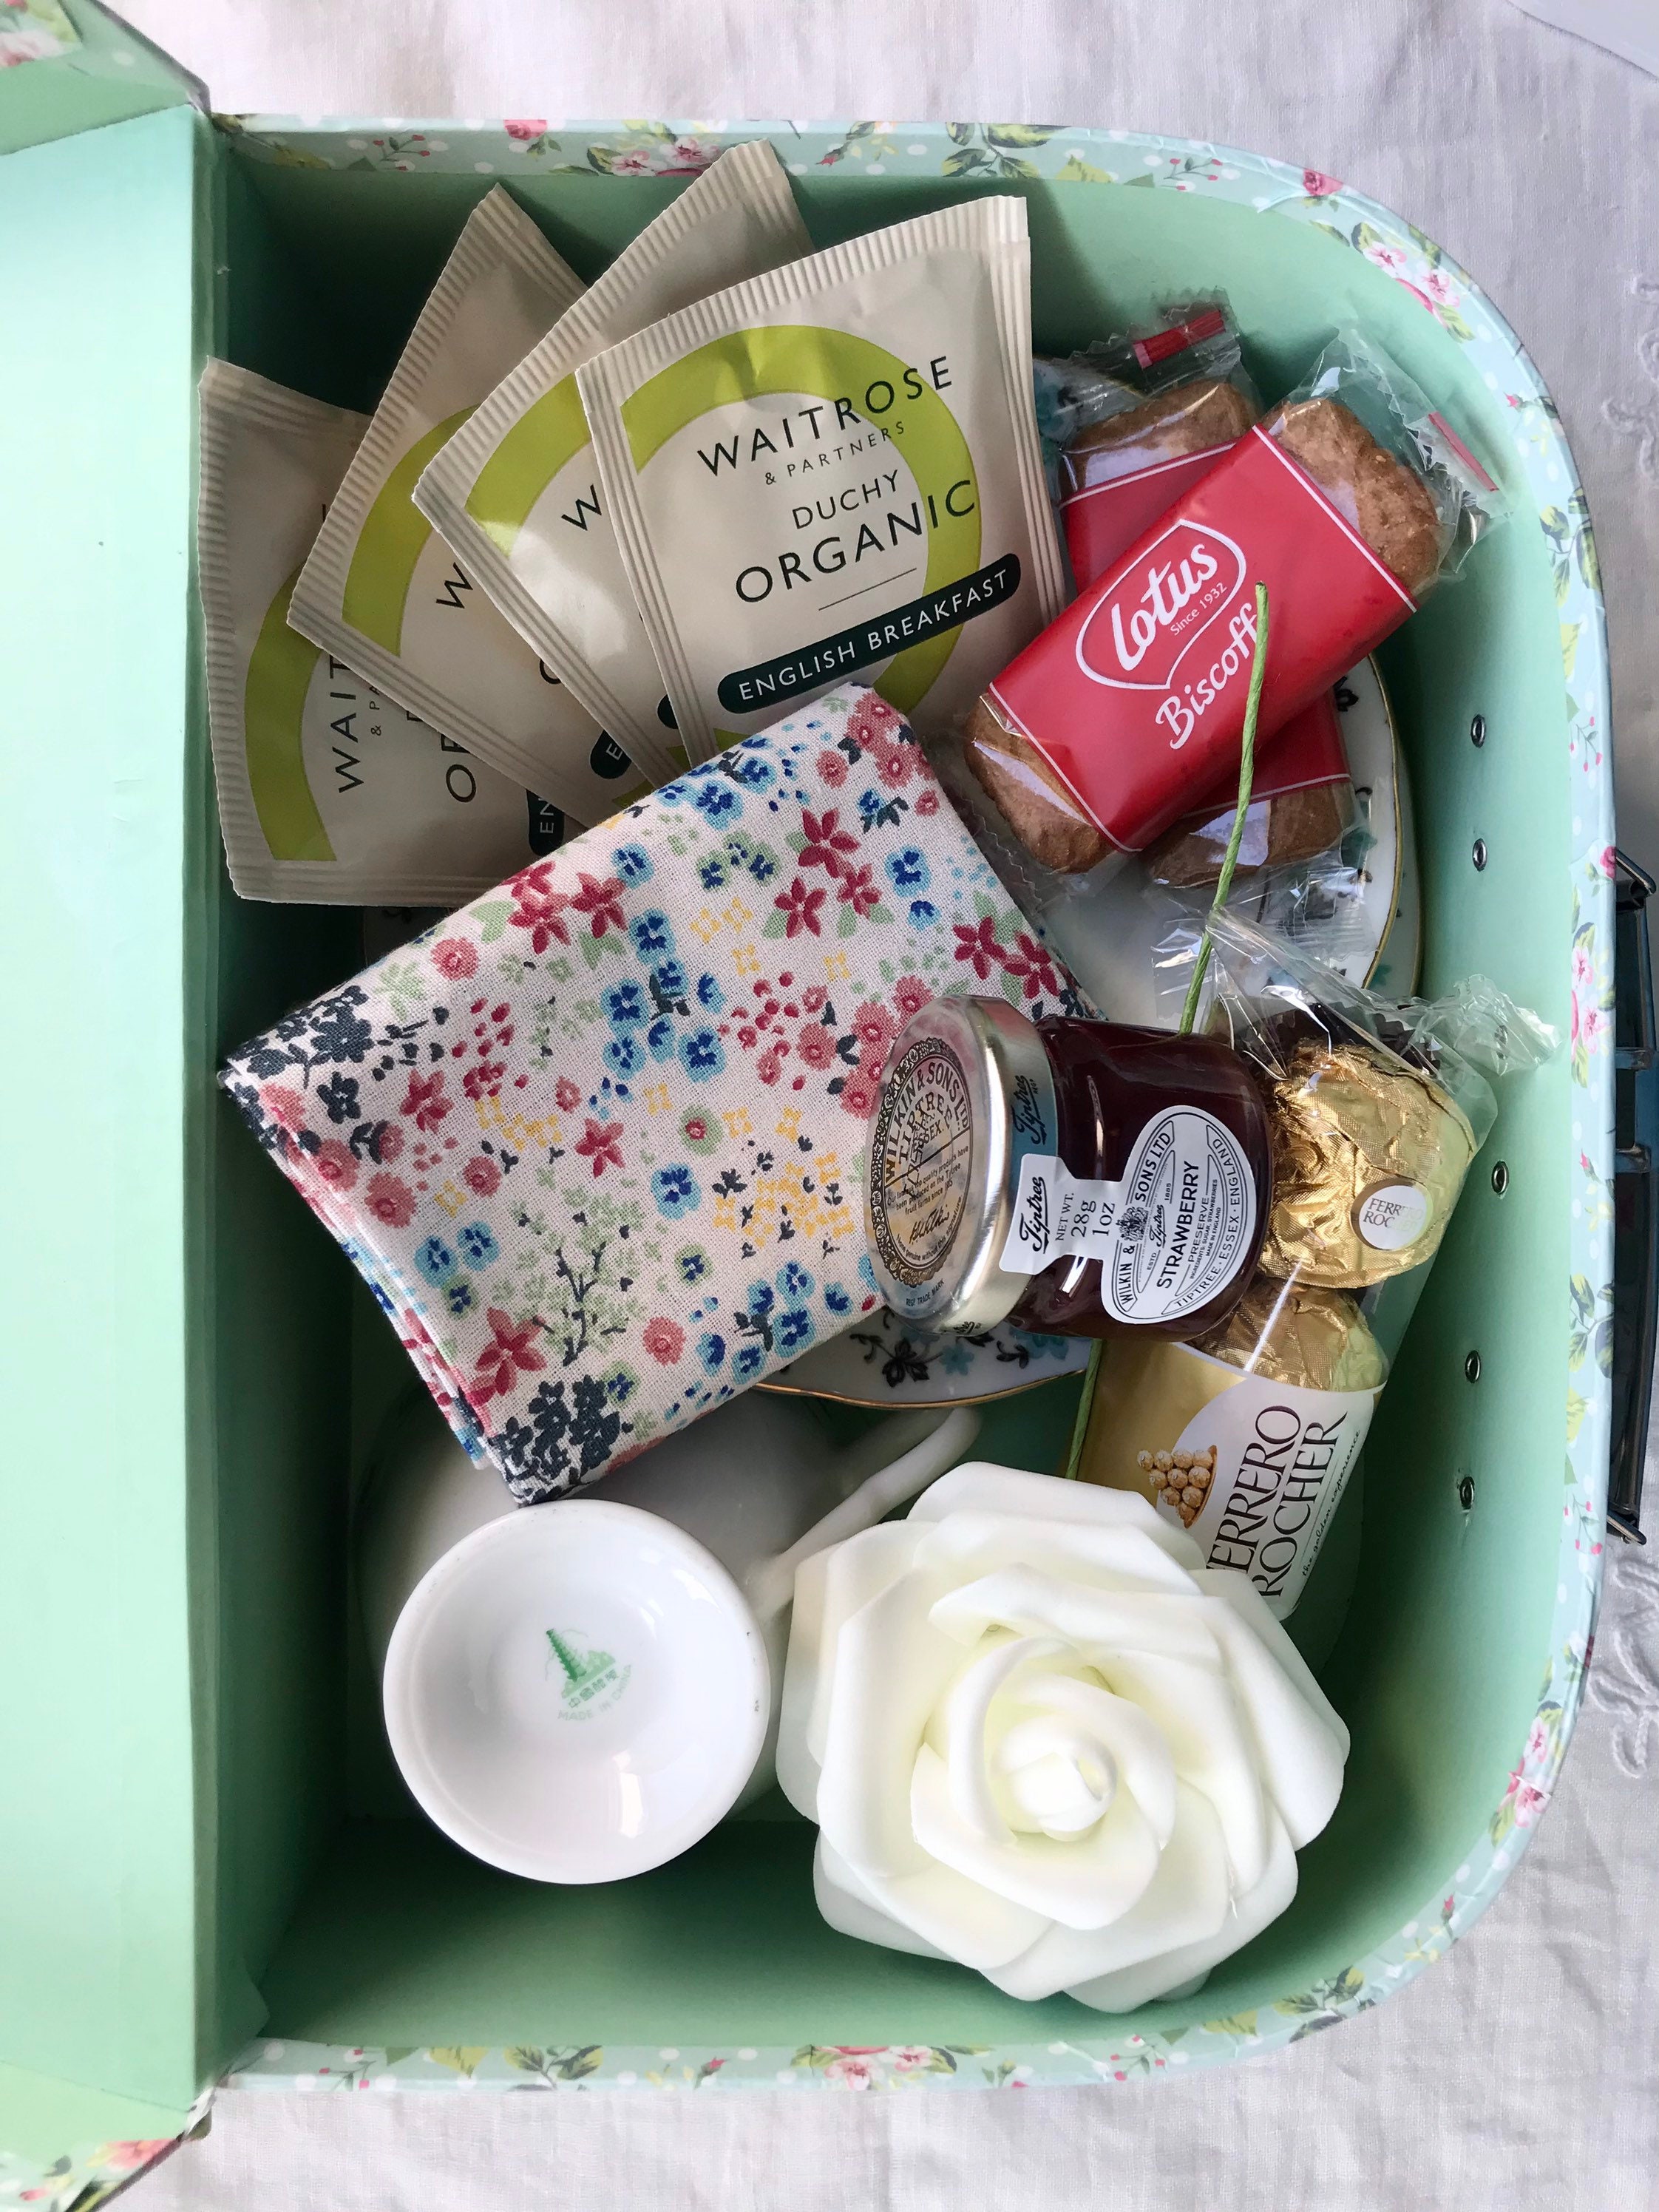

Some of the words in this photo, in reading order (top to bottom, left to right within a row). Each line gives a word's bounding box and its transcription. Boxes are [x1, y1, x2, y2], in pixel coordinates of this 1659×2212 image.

[696, 356, 952, 476] WAITROSE
[764, 471, 777, 486] &
[787, 421, 906, 477] PARTNERS
[792, 469, 900, 530] DUCHY
[736, 480, 976, 603] ORGANIC
[739, 642, 855, 702] ENGLISH
[868, 569, 1008, 651] BREAKFAST
[1111, 543, 1218, 671] Lotus
[1170, 608, 1200, 636] Since
[1199, 582, 1228, 609] 1932
[1155, 603, 1258, 750] Biscoff
[330, 655, 364, 793] WAIT
[885, 1077, 916, 1183] WILKIN
[917, 1068, 926, 1091] &
[926, 1062, 960, 1102] SONS
[1011, 1074, 1048, 1145] Tiptree
[1150, 1133, 1171, 1158] LTD
[1212, 1139, 1241, 1205] ENGLAND
[1061, 1192, 1074, 1215] WT.
[1135, 1158, 1157, 1202] SONS
[1207, 1178, 1218, 1223] STRAWBERRIES
[1020, 1176, 1050, 1254] Tiptree
[1055, 1218, 1068, 1241] NET
[1071, 1200, 1096, 1238] 28g
[1149, 1204, 1167, 1249] Tiptree
[1156, 1160, 1198, 1289] STRAWBERRY
[1188, 1197, 1210, 1263] PRESERVE
[1212, 1207, 1221, 1235] ENGLAND
[1218, 1215, 1240, 1260] ESSEX
[1122, 1245, 1136, 1255] &
[1119, 1263, 1133, 1305] WILKIN
[1174, 1266, 1222, 1306] TIPTREE
[1206, 1405, 1301, 1574] ERRERO
[1252, 1411, 1348, 1597] ROCHER
[1302, 1555, 1314, 1576] the
[1313, 1509, 1331, 1554] golden
[1331, 1429, 1361, 1502] experience
